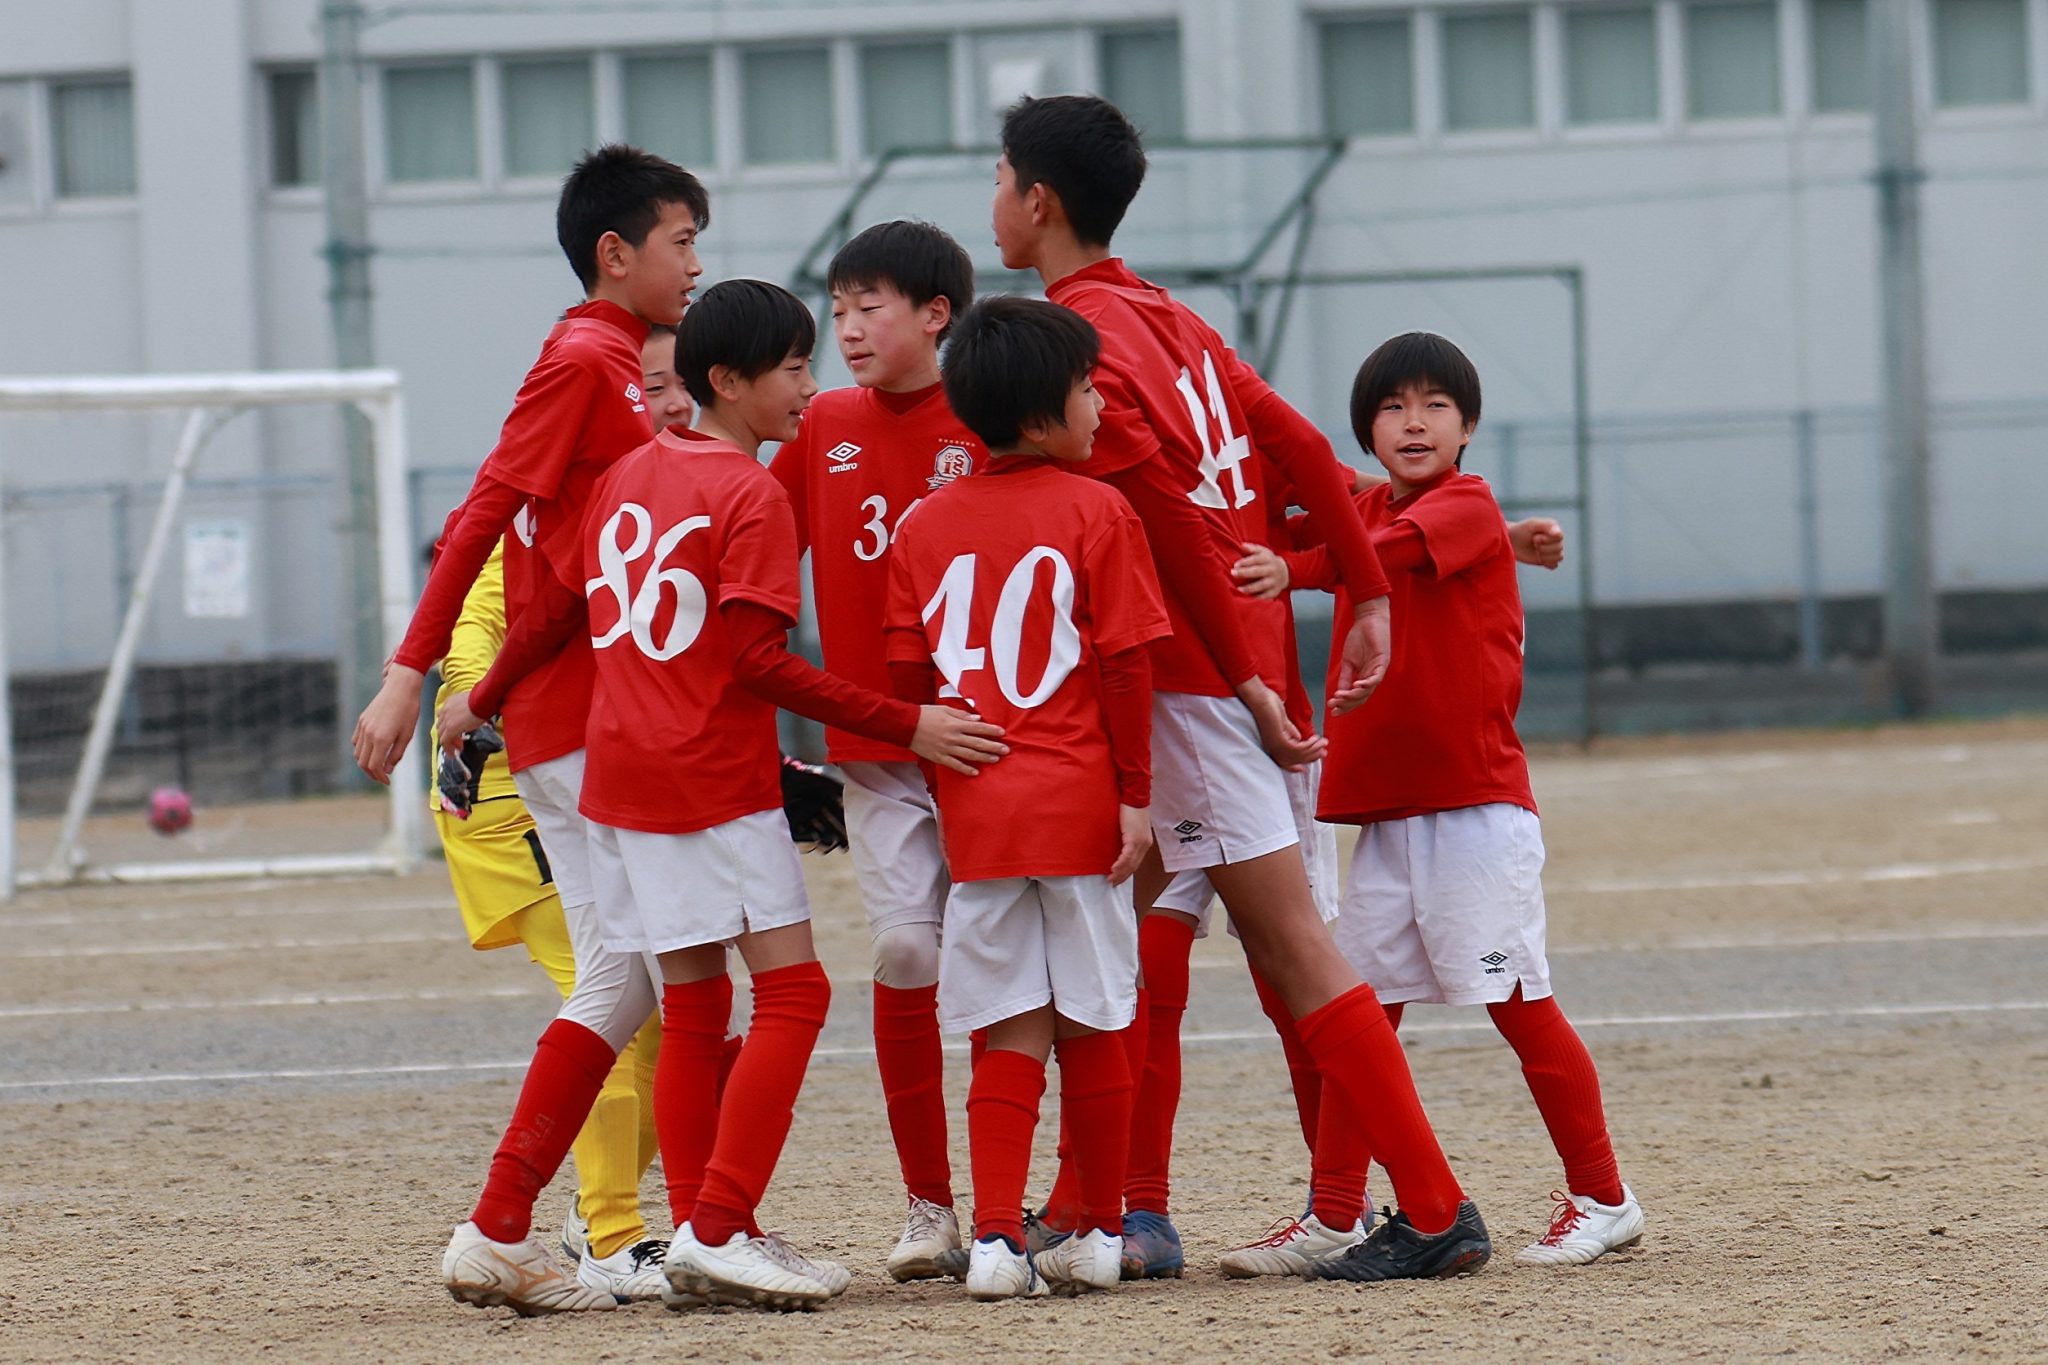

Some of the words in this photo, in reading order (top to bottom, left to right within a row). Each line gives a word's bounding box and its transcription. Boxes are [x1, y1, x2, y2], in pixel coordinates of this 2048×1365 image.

[829, 462, 858, 473] umbro
[1176, 350, 1256, 509] 14
[585, 502, 711, 661] 86
[921, 545, 1081, 709] 40
[1485, 966, 1505, 974] umbro
